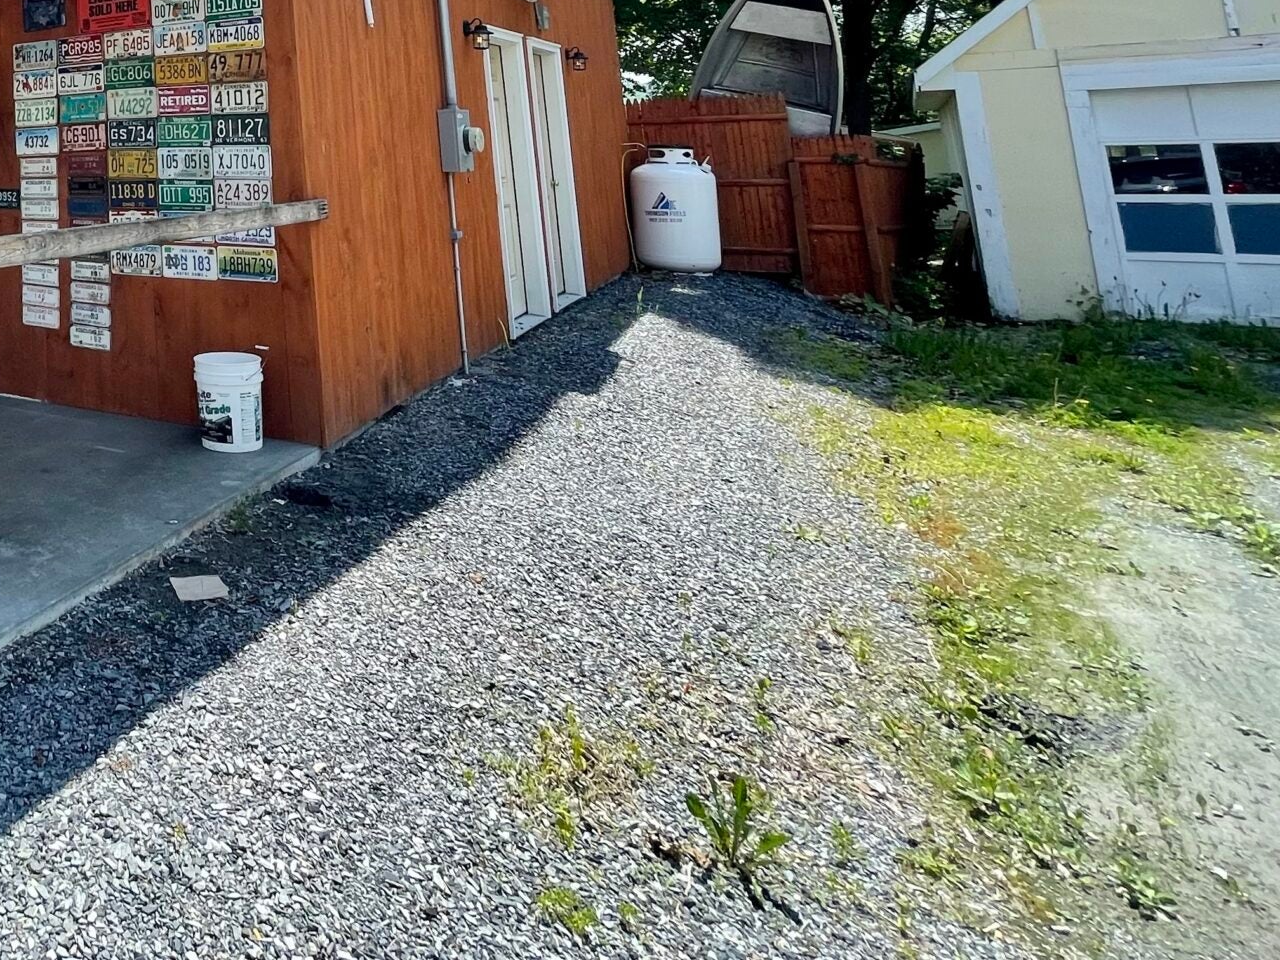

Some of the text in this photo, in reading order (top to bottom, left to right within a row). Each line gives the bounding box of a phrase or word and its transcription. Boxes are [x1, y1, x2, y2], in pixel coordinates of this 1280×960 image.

[89, 0, 139, 18] SOLD HERE
[61, 39, 102, 56] PGR985
[106, 36, 150, 55] PF 6485
[82, 72, 101, 87] 776
[111, 65, 151, 81] GC806
[160, 95, 207, 107] RETIRED
[215, 89, 264, 107] 41012
[164, 123, 208, 140] DH627
[217, 119, 264, 138] 81127
[24, 135, 49, 149] 43732
[218, 153, 265, 170] XJ7040
[111, 183, 144, 200] 11838
[189, 187, 209, 203] 995
[192, 255, 211, 272] 183
[205, 404, 231, 415] Grade
